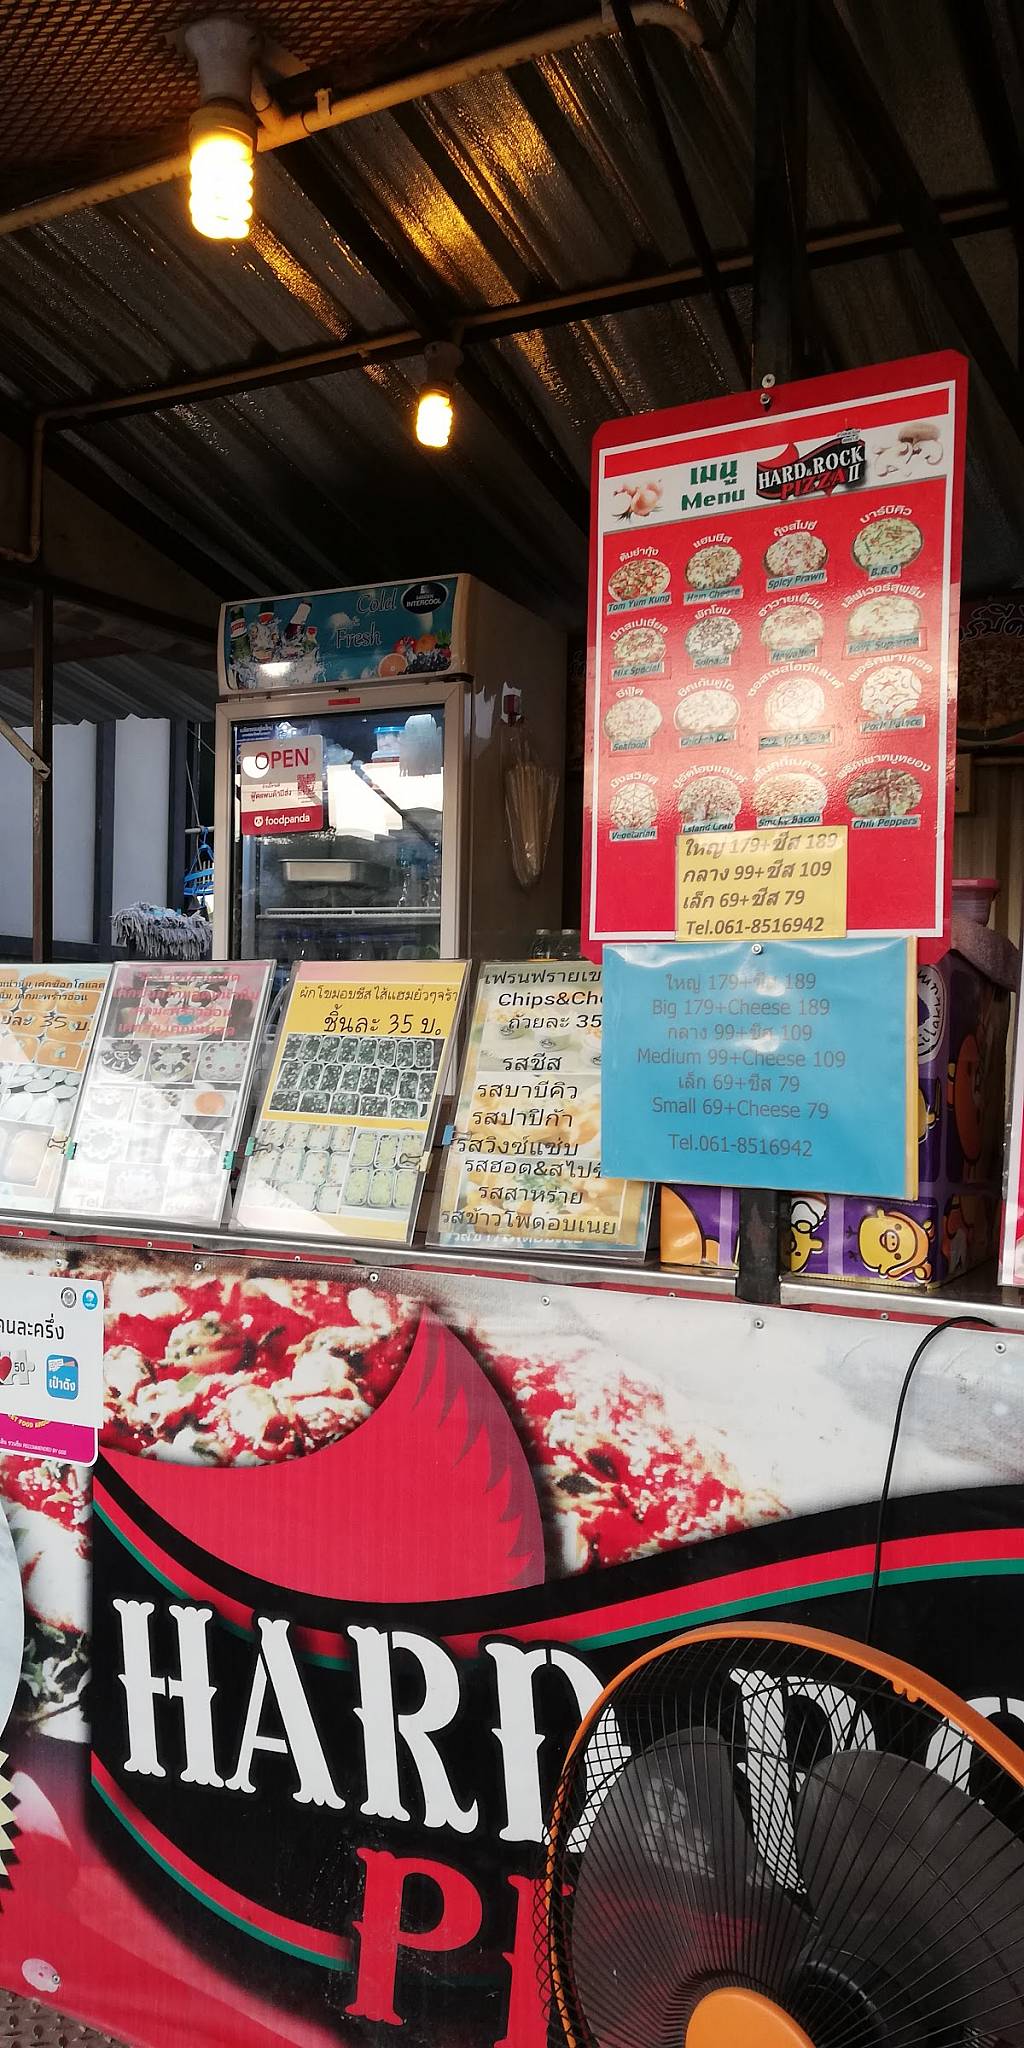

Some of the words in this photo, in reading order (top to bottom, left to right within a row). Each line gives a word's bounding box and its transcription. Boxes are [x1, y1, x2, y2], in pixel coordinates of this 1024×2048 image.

[690, 460, 738, 486] เมนู
[758, 463, 807, 490] HARD
[813, 446, 865, 475] ROCK
[780, 467, 847, 501] PIZZA
[681, 489, 745, 511] Menu
[767, 578, 793, 589] Spicy
[795, 571, 825, 584] Prawn
[356, 588, 397, 614] Cold
[608, 603, 626, 612] Tom
[629, 598, 647, 608] Yum
[648, 594, 670, 606] Kung
[336, 622, 383, 649] Fresh
[255, 747, 309, 769] OPEN
[265, 813, 310, 827] foodpanda
[791, 815, 821, 825] Bacon
[877, 816, 918, 828] Peppers
[683, 868, 729, 884] กลาง
[800, 861, 832, 878] 109
[683, 889, 715, 910] เล็ก
[784, 890, 805, 906] 79
[687, 915, 825, 936] Tel.061-8516942
[665, 973, 700, 993] ใหญ่
[785, 973, 817, 989] 189
[324, 1003, 380, 1034] ชิ้นละ
[388, 1014, 414, 1035] 35
[653, 999, 678, 1019] Big
[684, 999, 792, 1016] 179+Cheese
[798, 999, 830, 1016] 189
[40, 1014, 68, 1028] 35
[508, 1012, 570, 1030] ถ้วยละ
[576, 1014, 602, 1029] 35
[668, 1025, 708, 1041] กลาง
[781, 1025, 813, 1041] 109
[502, 1055, 563, 1071] รสชีส
[637, 1048, 702, 1065] Medium
[707, 1049, 806, 1068] 99+Cheese
[813, 1051, 846, 1068] 109
[678, 1071, 706, 1090] เล็ก
[779, 1076, 800, 1092] 79
[652, 1097, 696, 1114] Small
[702, 1097, 801, 1118] 69+Cheese
[807, 1102, 829, 1119] 79
[668, 1134, 812, 1158] Tel.061-8516942
[478, 1183, 584, 1204] รสสาหร่าย
[14, 1361, 26, 1373] 50
[112, 1598, 632, 1854] HARD
